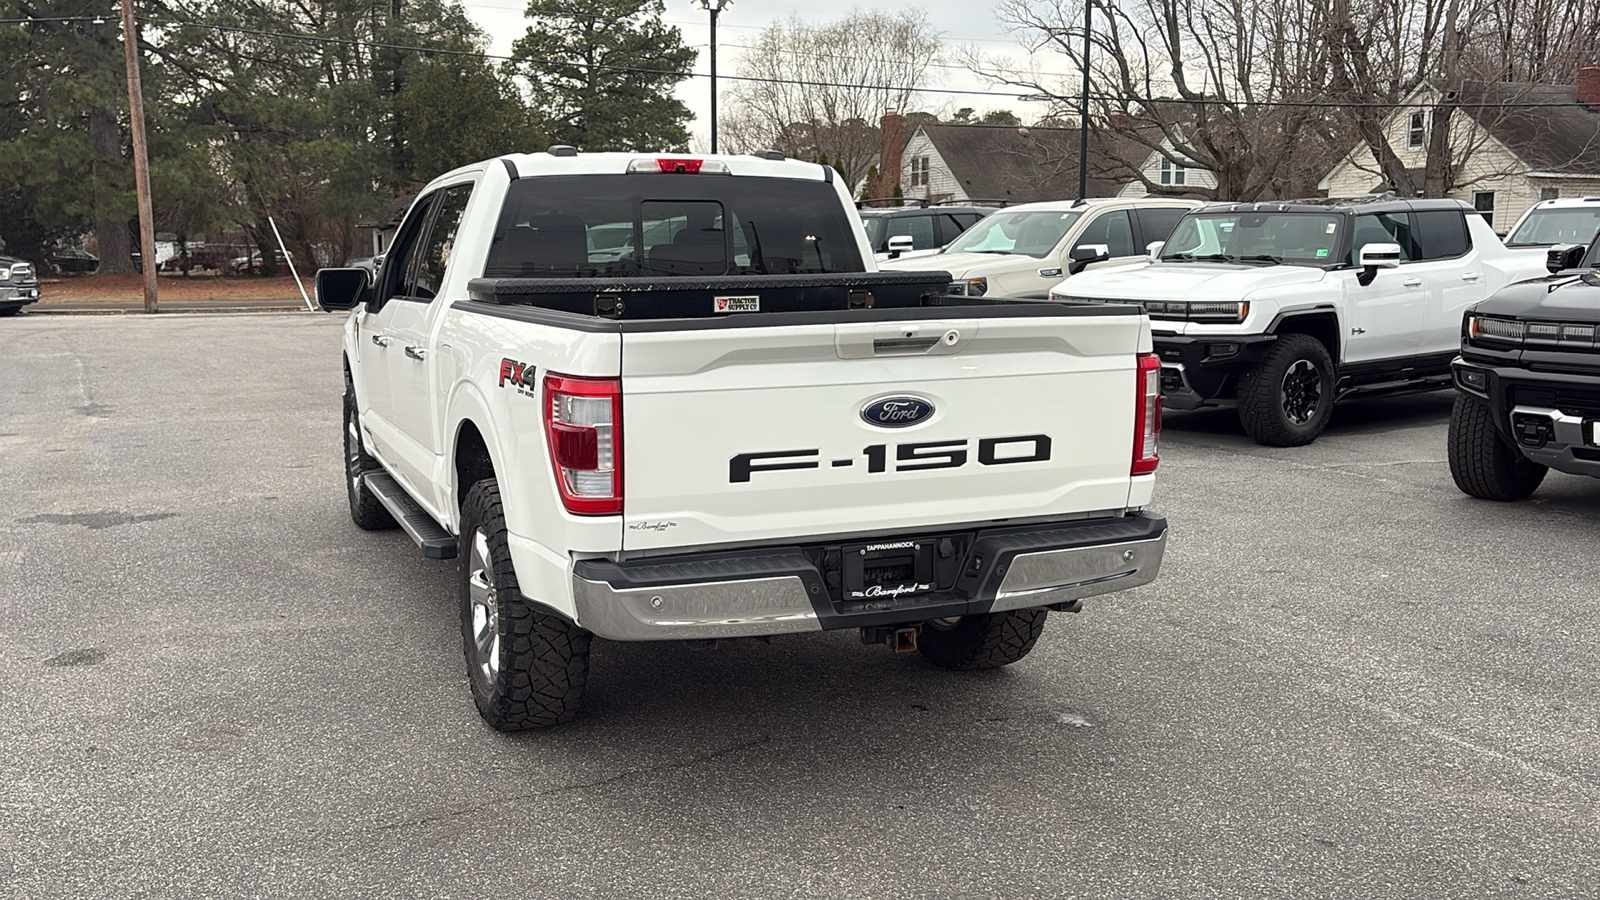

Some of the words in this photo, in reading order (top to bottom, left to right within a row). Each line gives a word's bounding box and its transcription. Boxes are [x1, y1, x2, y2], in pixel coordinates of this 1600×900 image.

[499, 358, 537, 391] FX4
[880, 402, 919, 420] Ford
[729, 434, 1052, 483] F-150
[867, 541, 914, 551] TAPPAHANNOCK
[866, 583, 918, 598] Bareford
